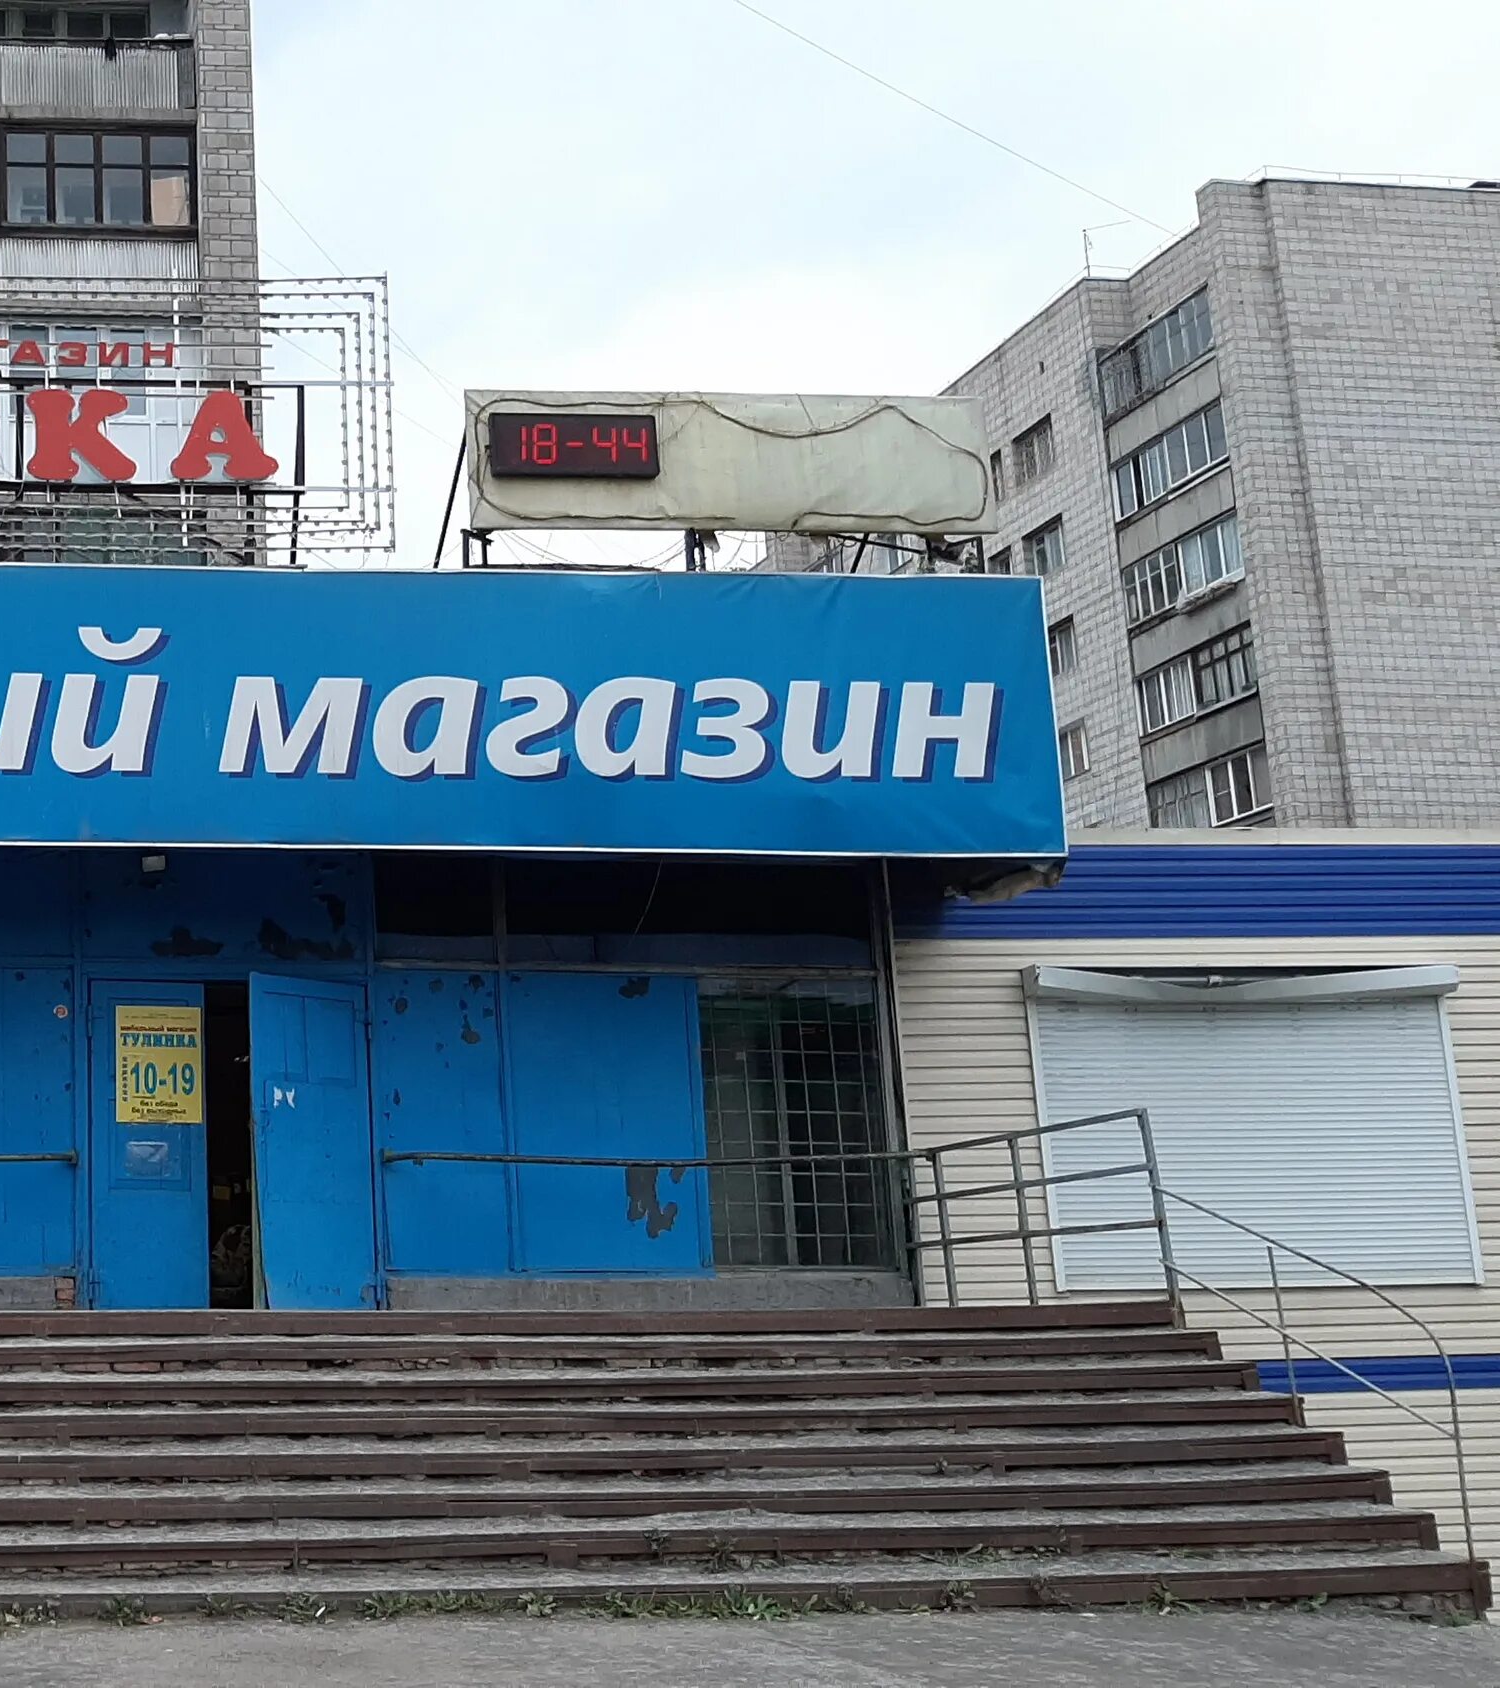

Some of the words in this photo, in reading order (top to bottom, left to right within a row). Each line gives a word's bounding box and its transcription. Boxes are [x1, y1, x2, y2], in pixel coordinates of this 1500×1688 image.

[519, 423, 649, 465] 18-44
[218, 675, 998, 779] магазин
[120, 1032, 198, 1048] ТУЛИНКА
[130, 1062, 195, 1096] 10-19
